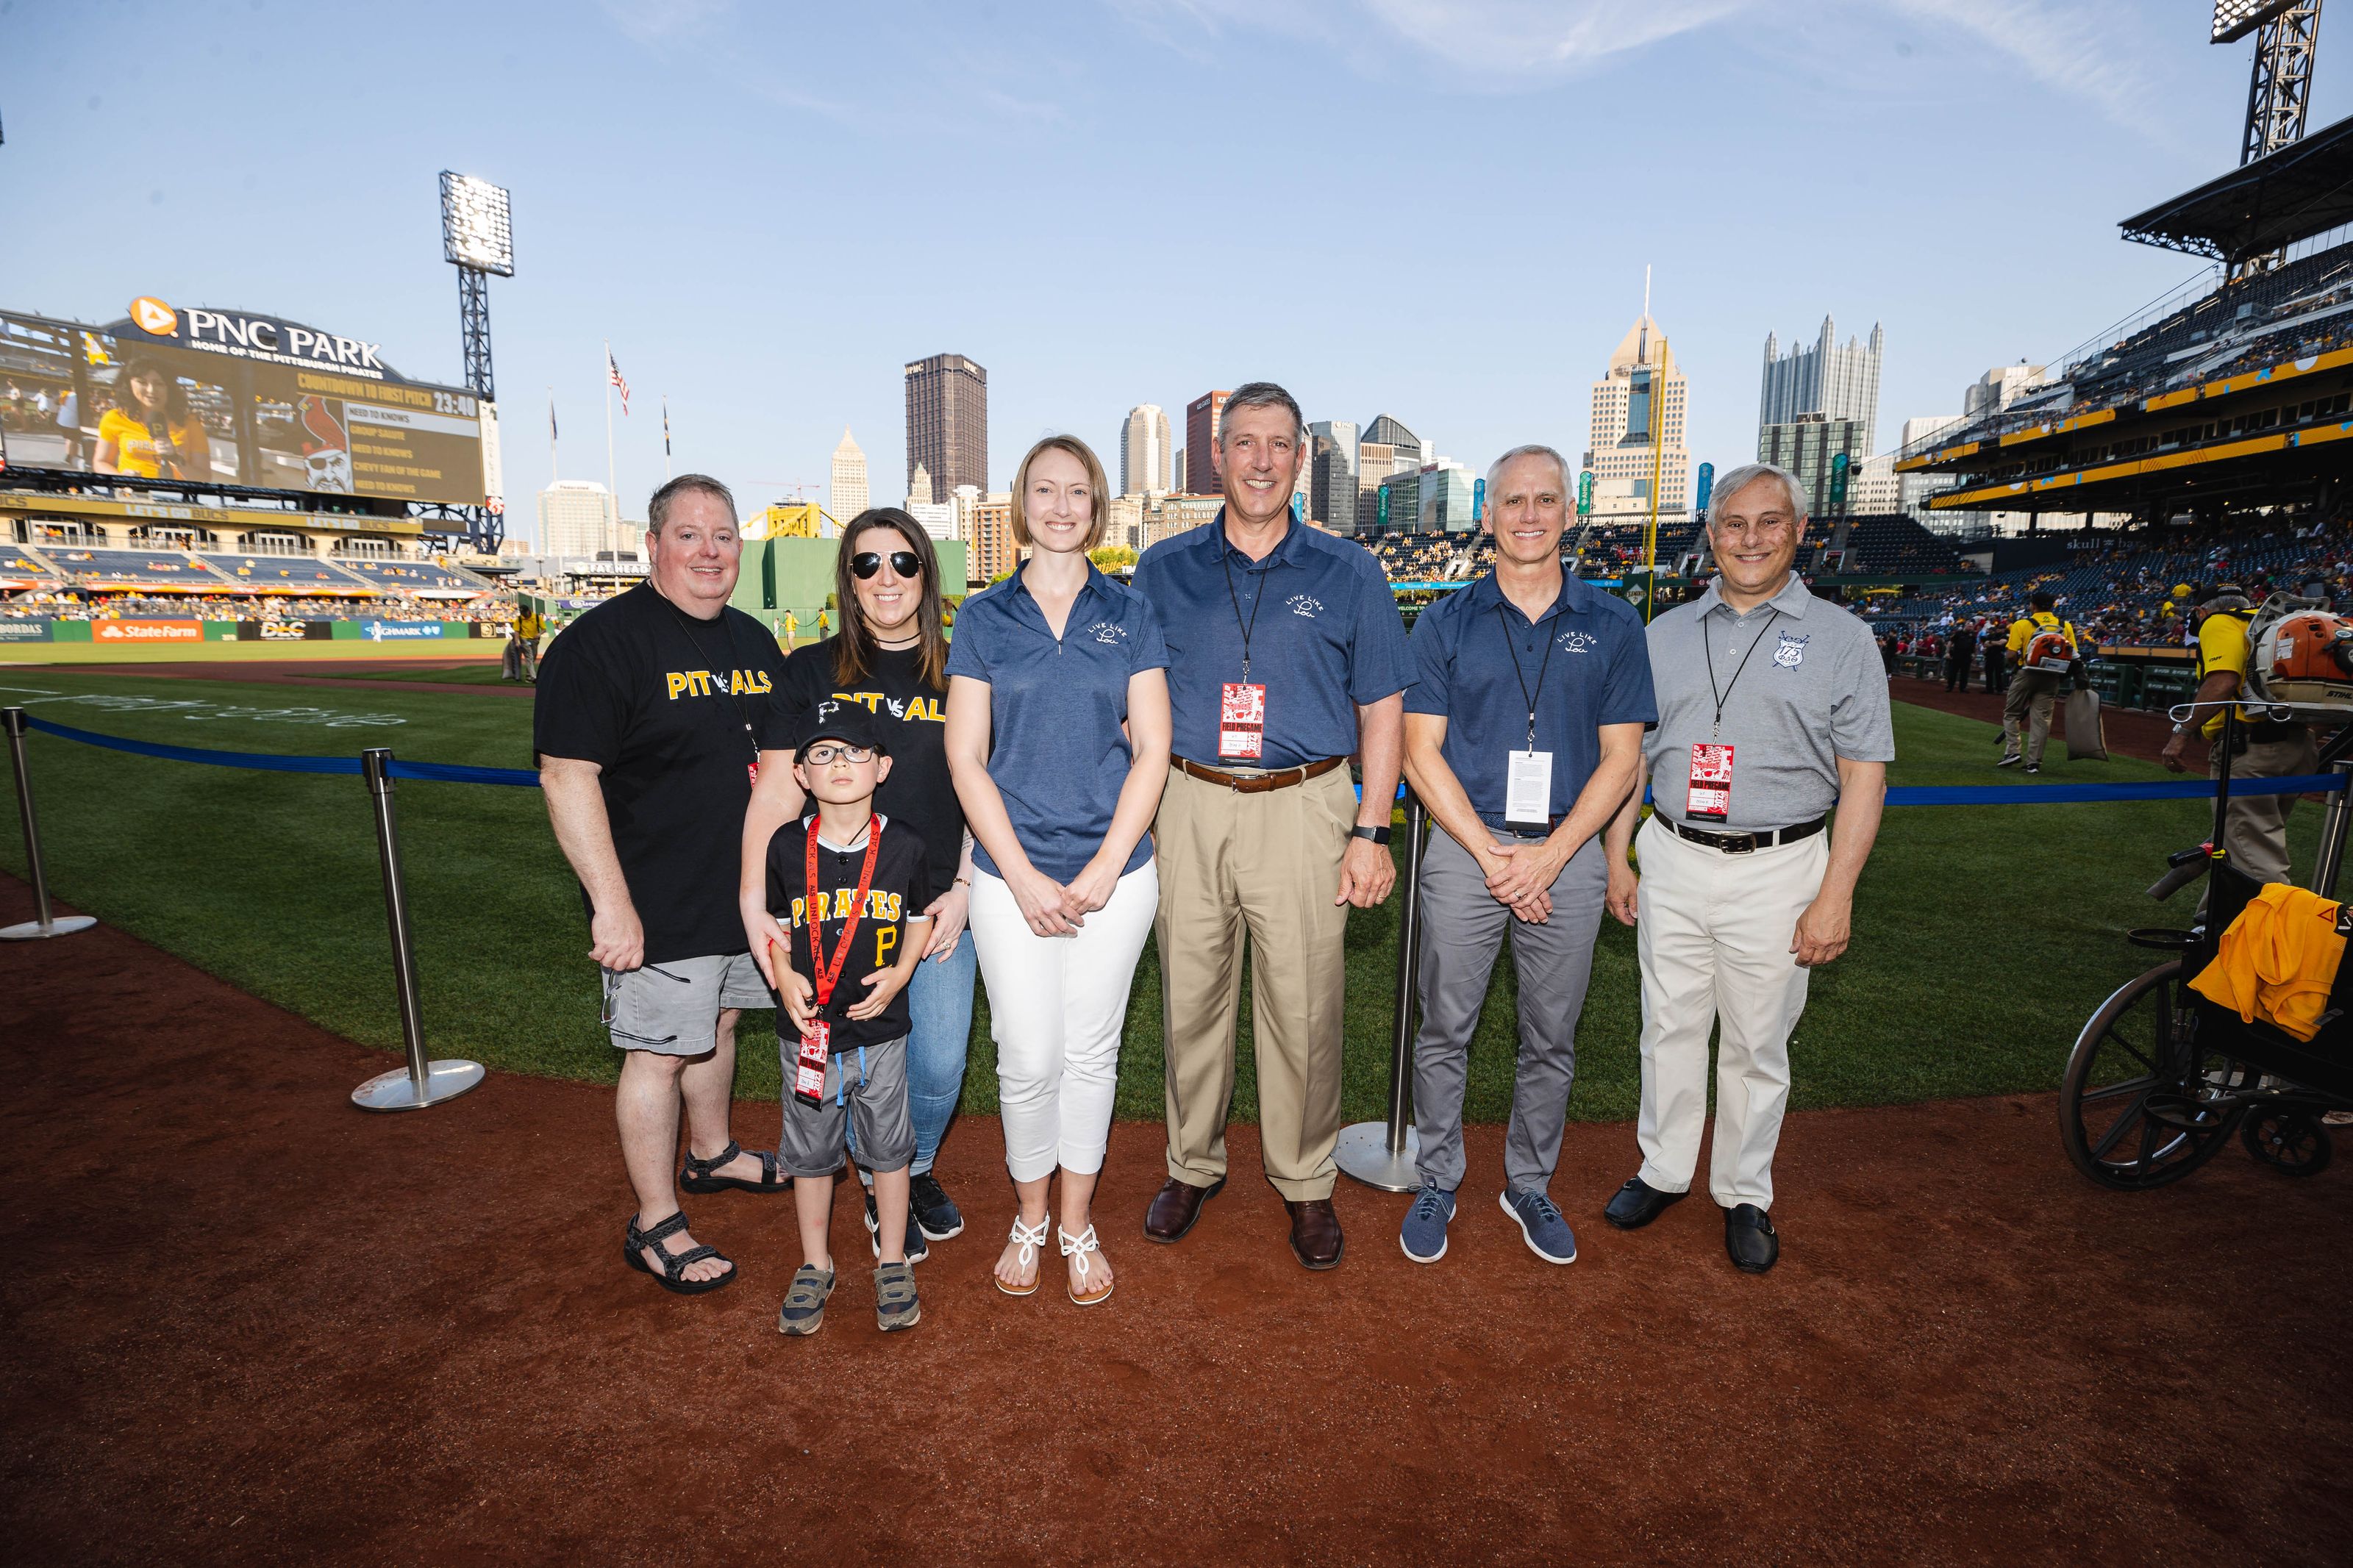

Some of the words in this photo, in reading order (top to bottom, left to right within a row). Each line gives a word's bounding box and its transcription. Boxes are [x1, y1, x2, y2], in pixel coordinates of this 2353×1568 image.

[183, 307, 278, 351] PNC
[284, 326, 383, 369] PARK
[191, 340, 229, 354] HOME
[230, 346, 248, 357] OF
[249, 349, 273, 362] THE
[273, 354, 341, 373] PITTSBURGH
[341, 365, 383, 379] PIRATES
[963, 359, 977, 374] UPMC
[297, 373, 364, 398] COUNTDOWN
[365, 384, 377, 395] TO
[379, 385, 404, 402] FIRST
[405, 390, 432, 407] PITCH
[434, 392, 476, 417] 23:40
[349, 407, 369, 417] NEED
[370, 409, 379, 419] TO
[382, 411, 410, 423] KNOWS
[350, 425, 377, 437] GROUP
[351, 443, 371, 454] NEED
[373, 445, 383, 455] TO
[384, 447, 413, 459] KNOWS
[353, 462, 379, 473] CHEVY
[380, 464, 396, 474] FAN
[420, 468, 441, 479] GAME
[355, 479, 375, 489] NEED
[375, 482, 386, 491] TO
[387, 483, 415, 493] KNOWS
[126, 504, 167, 517] LET'S
[171, 506, 191, 519] GO
[193, 508, 229, 520] BUCS
[306, 516, 341, 529] LET'S
[342, 518, 360, 530] GO
[360, 520, 390, 531] BUCS
[2066, 537, 2100, 549] skull
[590, 564, 611, 573] FAT
[1097, 559, 1129, 575] Miller
[1286, 595, 1304, 605] LIVE
[1308, 596, 1324, 611] LIKE
[1293, 601, 1315, 617] Lou
[260, 621, 306, 637] DLC
[1088, 623, 1106, 633] LIVE
[1110, 623, 1127, 637] LIKE
[1096, 629, 1118, 644] Lou
[1557, 631, 1575, 642] LIVE
[1579, 632, 1597, 645] LIKE
[1565, 637, 1588, 653] Lou
[1779, 645, 1802, 656] 175
[666, 670, 711, 700] PIT
[731, 670, 772, 695] ALS
[2326, 690, 2353, 699] STIHL
[886, 698, 904, 718] VS
[1222, 722, 1235, 731] FIELD
[1237, 723, 1262, 732] PREGAME
[1691, 779, 1703, 789] FIELD
[1704, 780, 1730, 791] PREGAME
[1715, 790, 1724, 809] 2023
[809, 823, 818, 859] UNLOCK
[860, 849, 876, 886] UNLOCK
[810, 903, 819, 942] UNLOCK
[833, 928, 852, 967] UNLOCK
[849, 911, 859, 926] ALS
[875, 925, 897, 967] P
[813, 945, 821, 962] ALS
[827, 971, 835, 984] ALS
